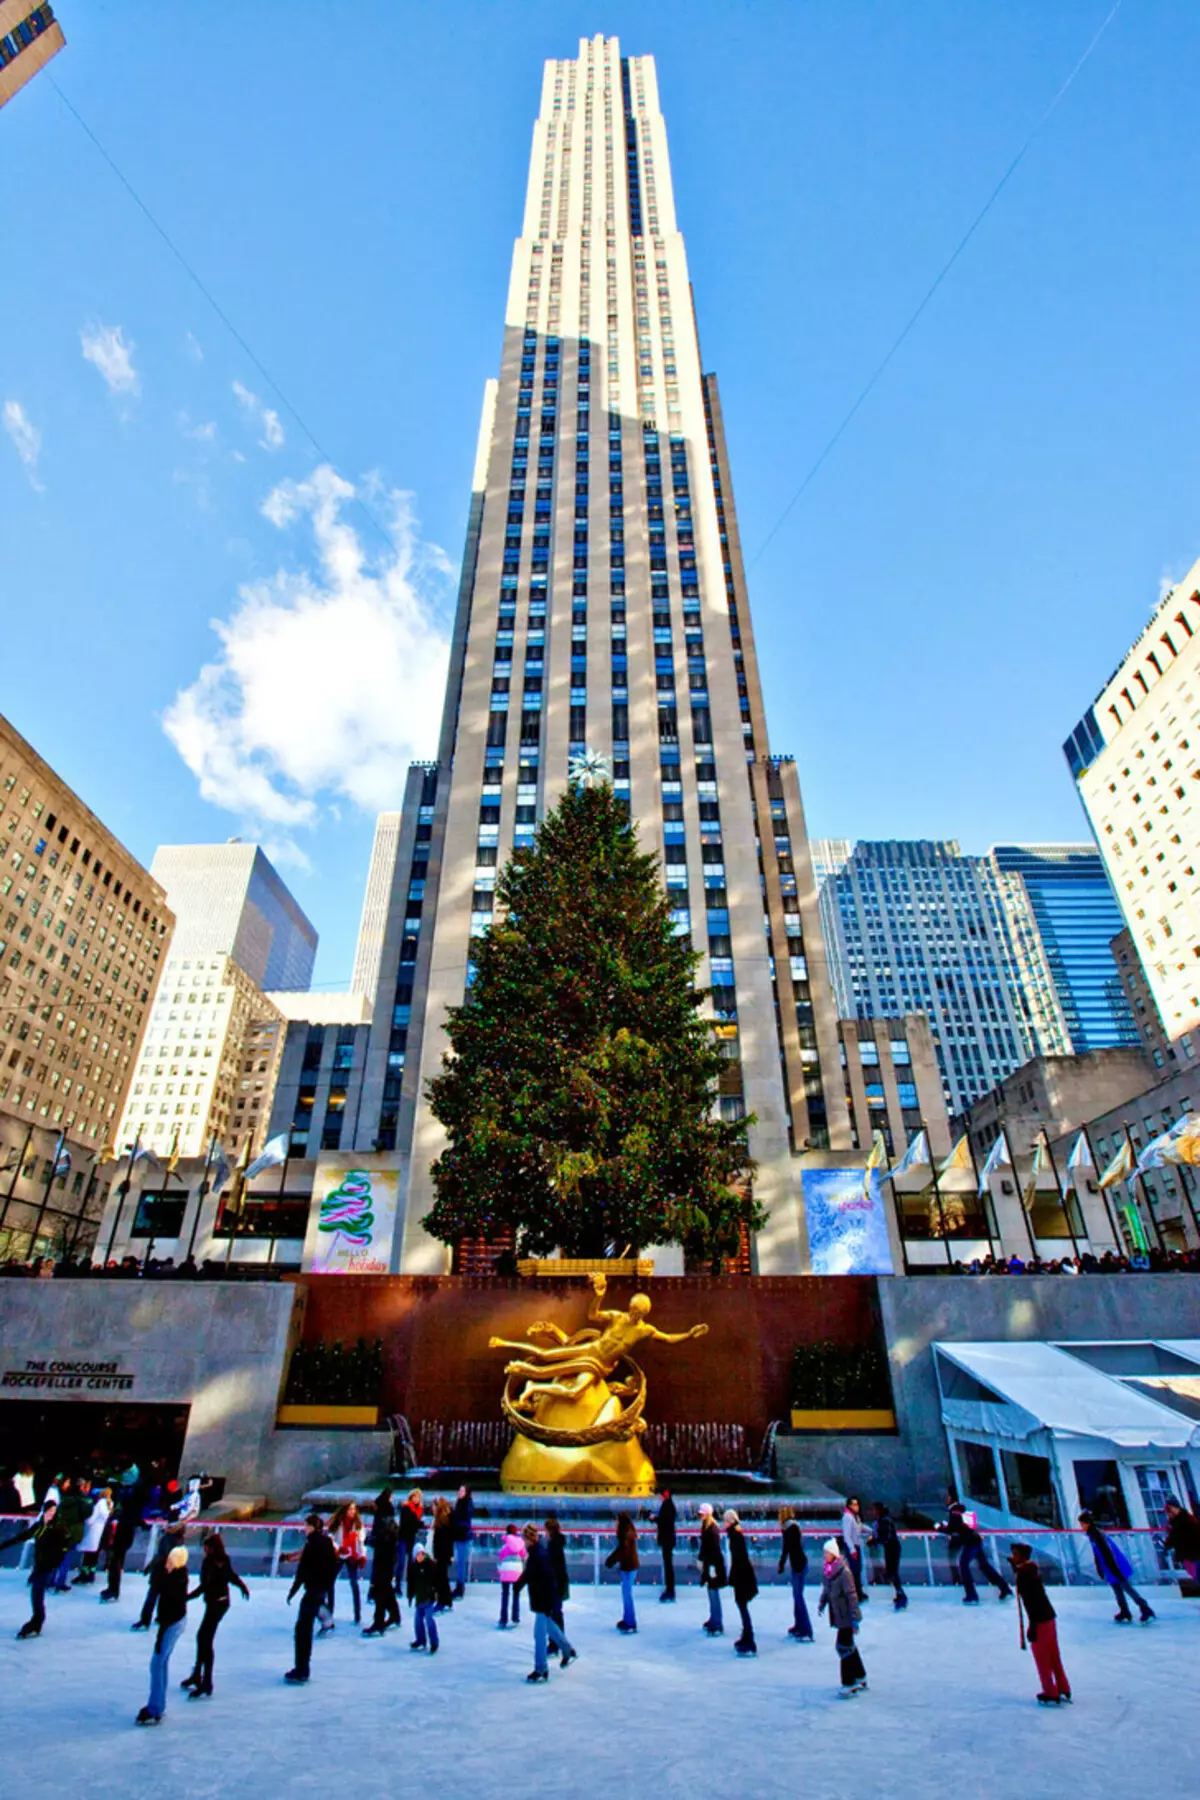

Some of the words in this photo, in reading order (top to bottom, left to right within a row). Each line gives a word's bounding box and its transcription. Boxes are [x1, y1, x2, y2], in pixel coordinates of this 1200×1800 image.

[26, 1360, 46, 1371] THE
[49, 1361, 118, 1373] CONCOURSE
[1, 1375, 83, 1388] ROCKEFELLER
[87, 1377, 134, 1389] CENTER
